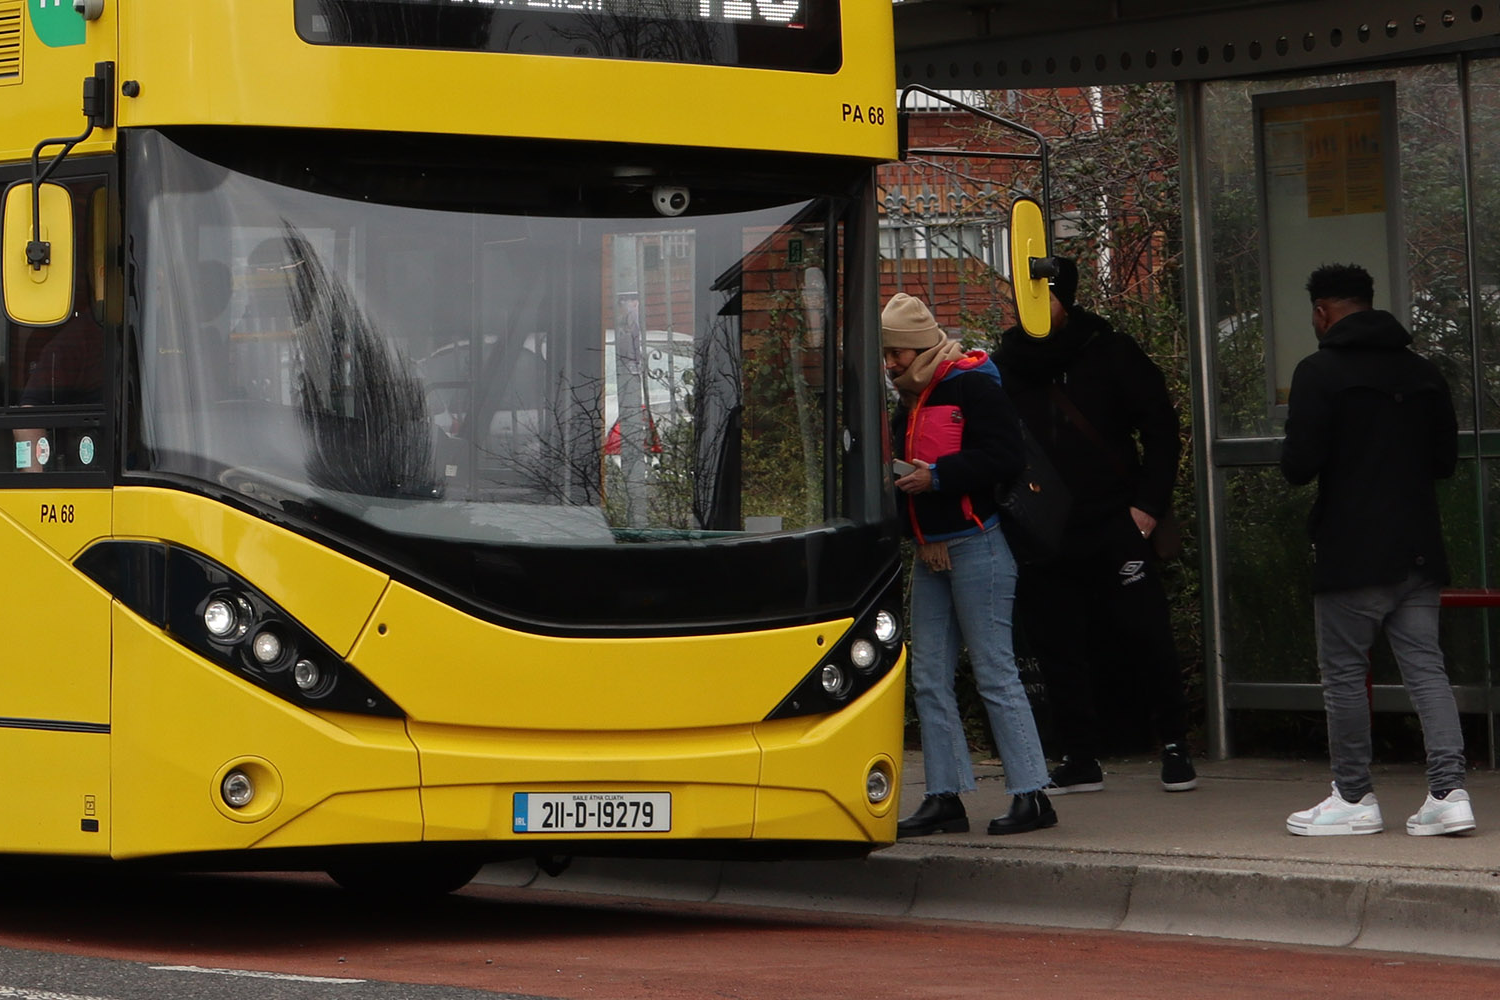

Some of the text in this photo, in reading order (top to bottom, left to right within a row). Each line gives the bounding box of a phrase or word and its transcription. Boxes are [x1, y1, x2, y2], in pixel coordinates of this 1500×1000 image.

[842, 103, 885, 126] PA 68
[40, 504, 74, 523] PA 68
[515, 817, 527, 826] IRL
[542, 801, 654, 828] 211-D-19279
